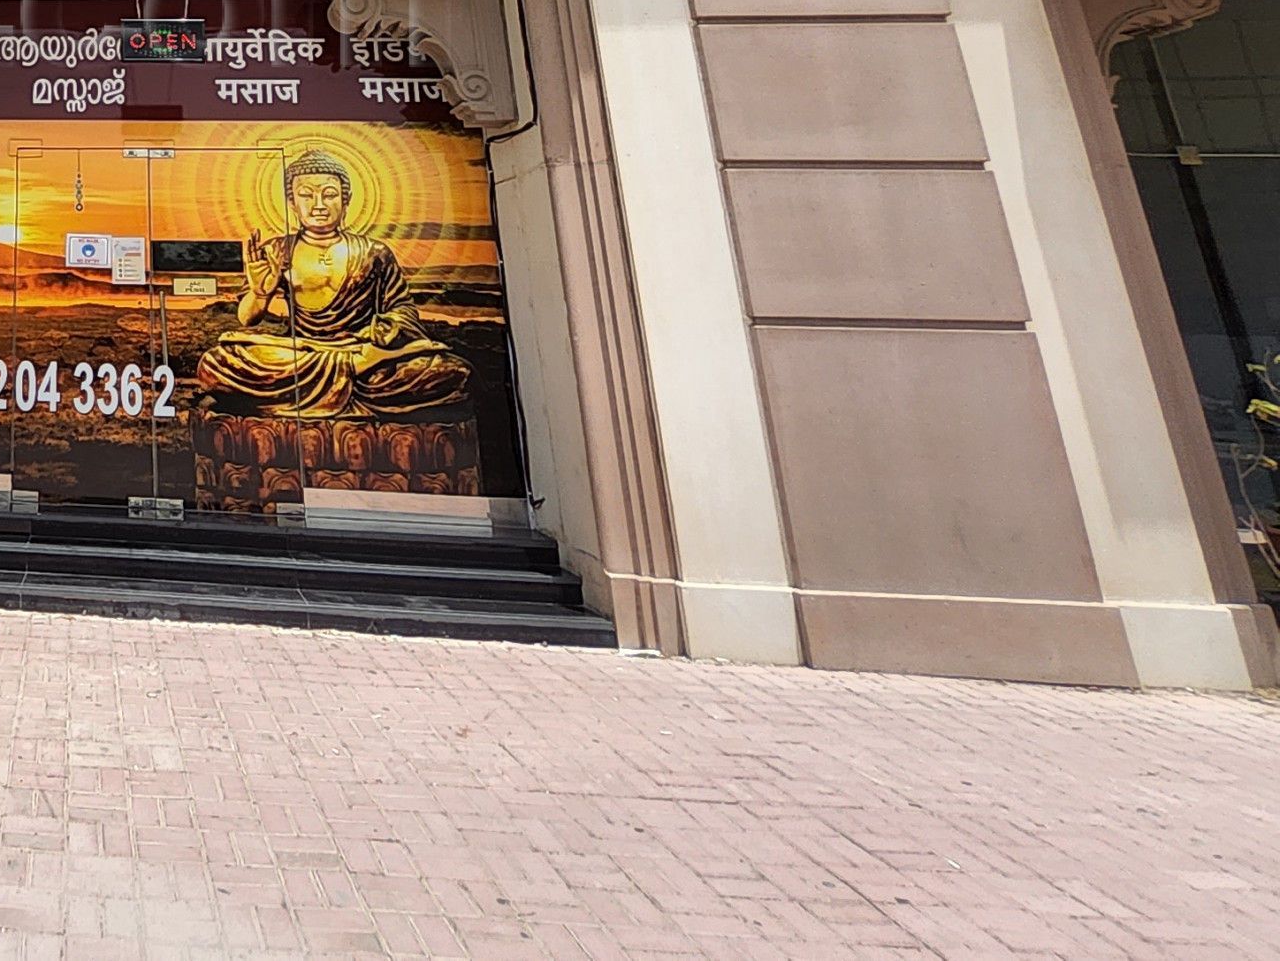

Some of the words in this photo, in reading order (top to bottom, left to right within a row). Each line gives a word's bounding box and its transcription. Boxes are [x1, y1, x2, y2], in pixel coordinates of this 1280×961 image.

[129, 33, 196, 50] OPEN
[215, 78, 300, 104] मसाज
[73, 361, 176, 417] 3362
